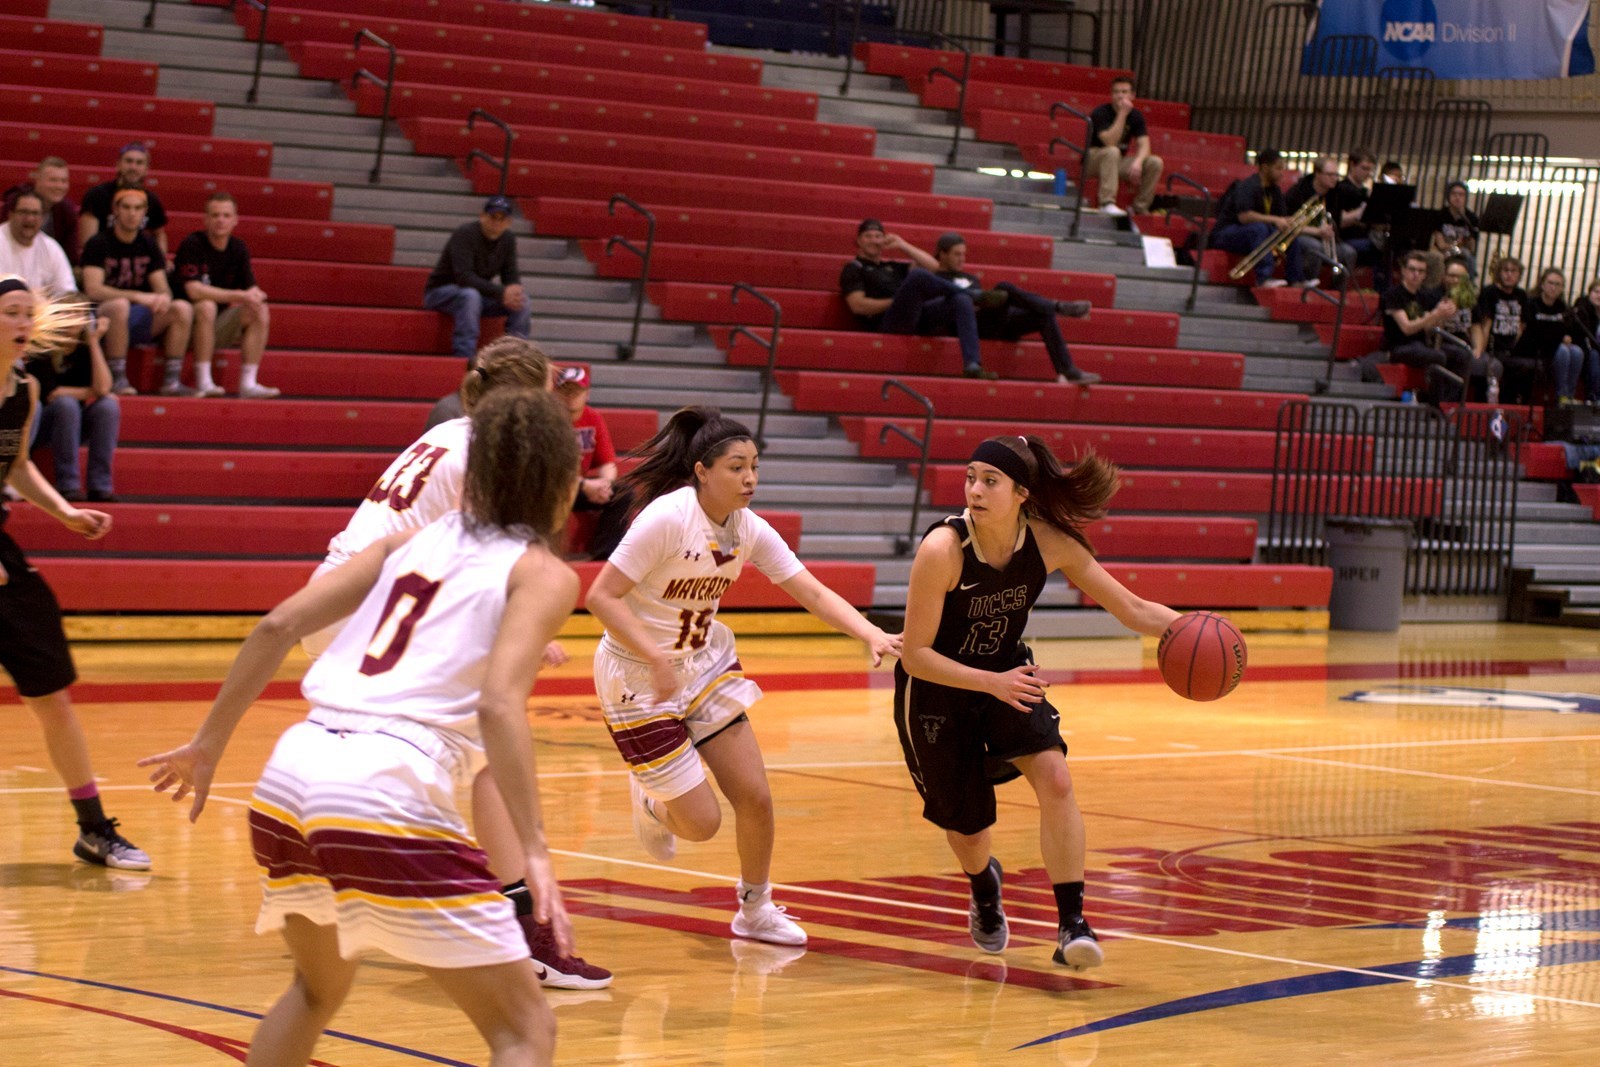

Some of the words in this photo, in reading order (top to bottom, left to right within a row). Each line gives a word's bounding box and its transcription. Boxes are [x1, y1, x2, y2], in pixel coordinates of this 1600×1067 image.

[1384, 21, 1435, 42] NCAA
[1442, 22, 1503, 42] Division
[366, 442, 450, 513] 33
[662, 576, 736, 600] MAVERIC
[968, 585, 1028, 618] UCCS
[358, 570, 444, 677] 0
[674, 608, 714, 650] 15
[959, 616, 1008, 655] 13
